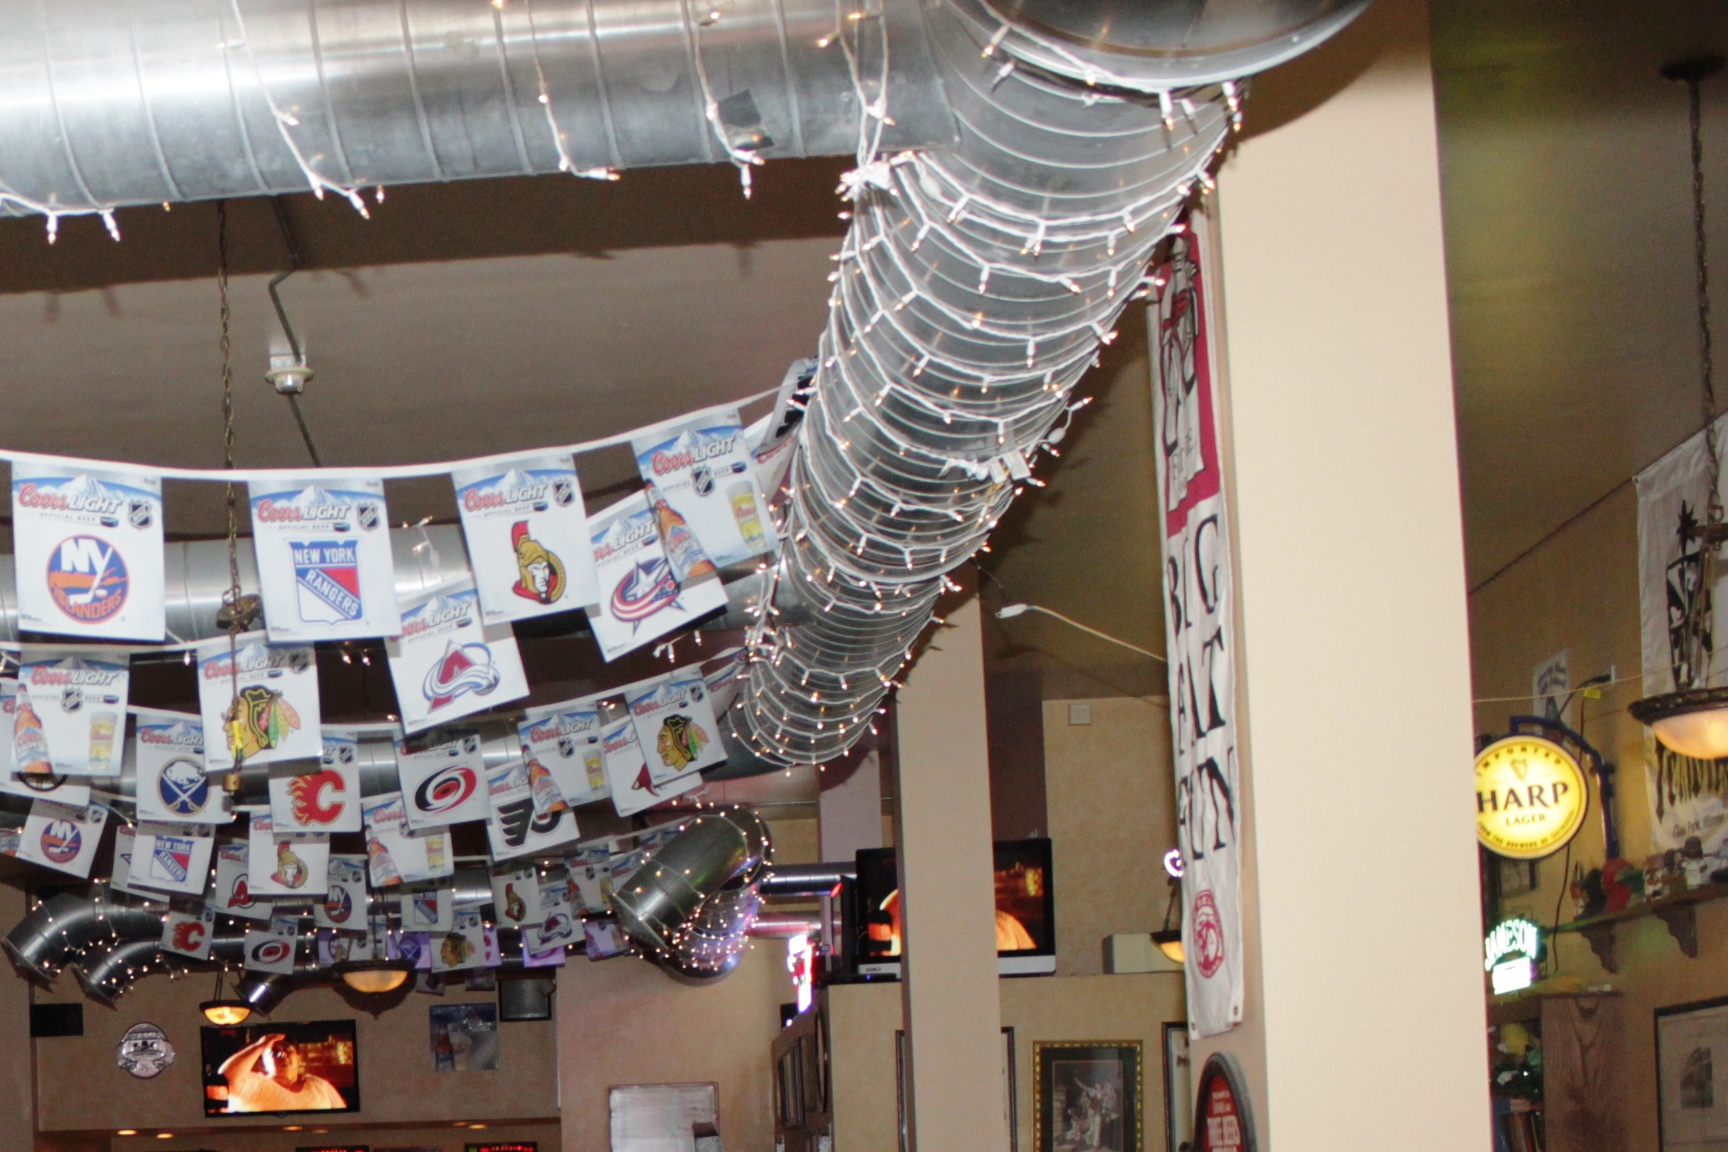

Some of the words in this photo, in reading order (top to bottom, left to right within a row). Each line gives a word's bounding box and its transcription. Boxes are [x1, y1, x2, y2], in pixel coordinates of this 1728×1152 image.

[651, 450, 694, 476] Coors
[693, 436, 736, 462] LIGHT
[19, 483, 68, 511] Coors
[67, 495, 123, 514] LIGHT
[257, 498, 302, 523] Coors
[302, 505, 351, 521] LIGHT
[463, 488, 505, 512] Coors
[504, 484, 548, 503] LIGHT
[612, 519, 655, 552] LIGHT
[294, 548, 321, 564] NEW
[324, 547, 356, 563] YORK
[305, 568, 359, 617] RANGERS
[427, 602, 471, 629] LIGHT
[31, 665, 73, 686] Coors
[71, 671, 117, 686] LIGHT
[240, 655, 283, 672] LIGHT
[141, 729, 173, 745] Coors
[530, 725, 561, 744] Coors
[559, 719, 593, 735] LIGHT
[1476, 745, 1561, 777] IMPORTED
[1476, 781, 1568, 813] HARP
[1506, 813, 1546, 827] LAGER
[155, 840, 171, 849] NEW
[172, 841, 191, 851] YORK
[158, 851, 186, 881] RANGERS
[1484, 918, 1538, 972] JAMESON
